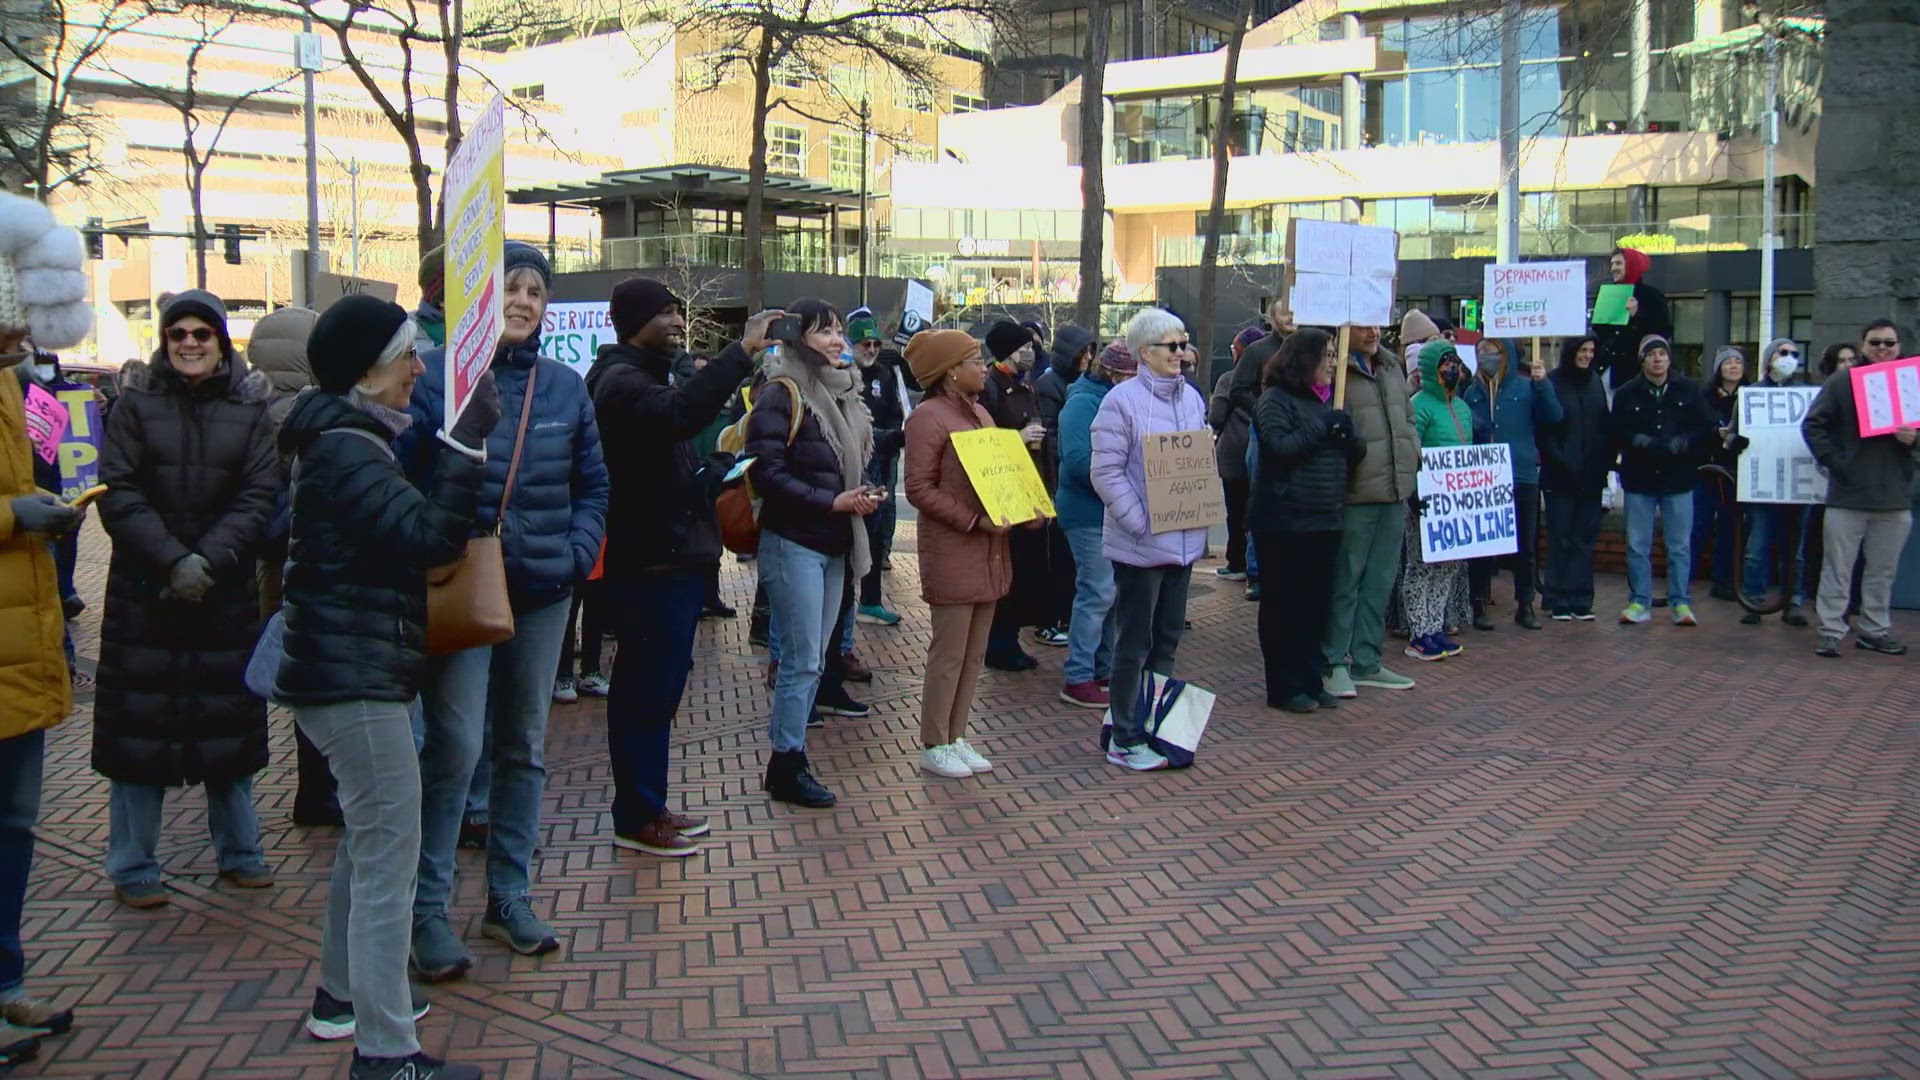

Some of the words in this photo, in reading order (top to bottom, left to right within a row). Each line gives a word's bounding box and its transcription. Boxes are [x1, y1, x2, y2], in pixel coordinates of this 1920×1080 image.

[1494, 268, 1570, 286] DEPARTMENT
[1494, 286, 1514, 299] OF
[1493, 299, 1548, 315] GREEDY
[1159, 434, 1193, 453] PRO
[1422, 450, 1452, 470] MAKE
[1454, 446, 1480, 468] ELON
[1480, 445, 1507, 466] MUSK
[1147, 459, 1170, 478] CIVIL
[1168, 478, 1209, 496] AGAINST
[1445, 469, 1494, 492] RESIGN
[1750, 457, 1825, 501] LIE
[1421, 493, 1452, 518] FED
[1453, 483, 1514, 513] WORKERS
[1427, 517, 1473, 553] HOLD
[1474, 507, 1515, 543] LINE
